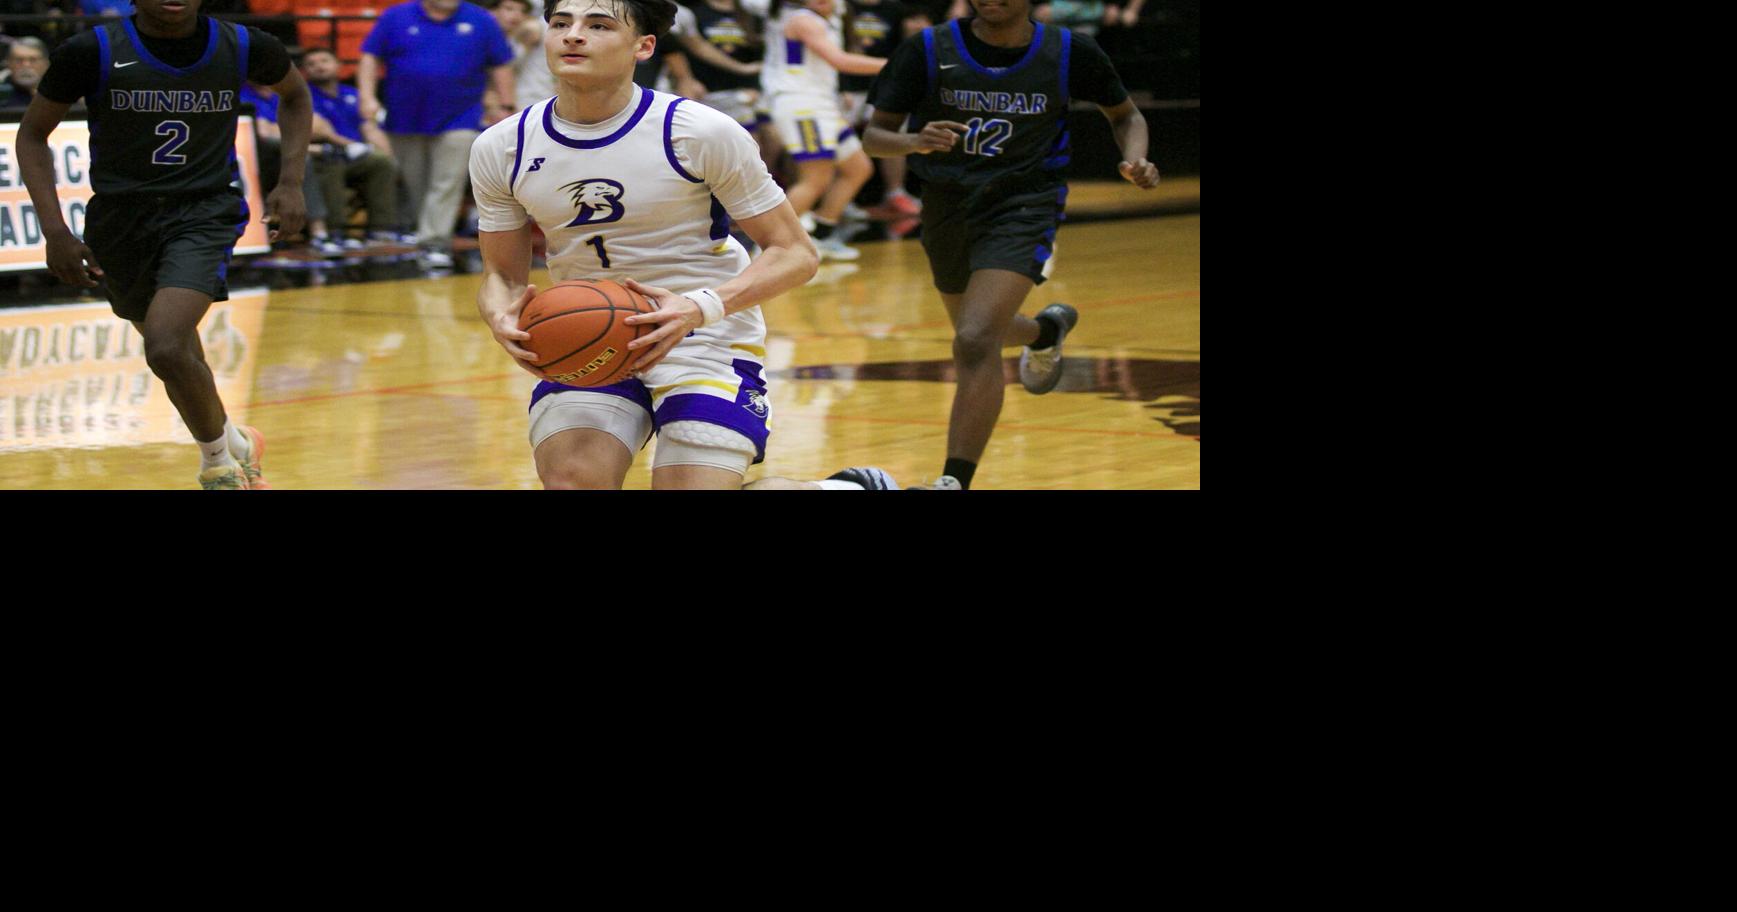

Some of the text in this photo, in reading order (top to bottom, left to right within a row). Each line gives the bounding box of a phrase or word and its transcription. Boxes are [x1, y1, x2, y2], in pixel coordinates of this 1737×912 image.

[110, 89, 234, 113] DUNBAR
[940, 88, 1048, 115] DUNBAR
[152, 120, 190, 165] 2
[964, 117, 1013, 157] 12
[0, 203, 86, 246] ADC
[586, 235, 611, 269] 1
